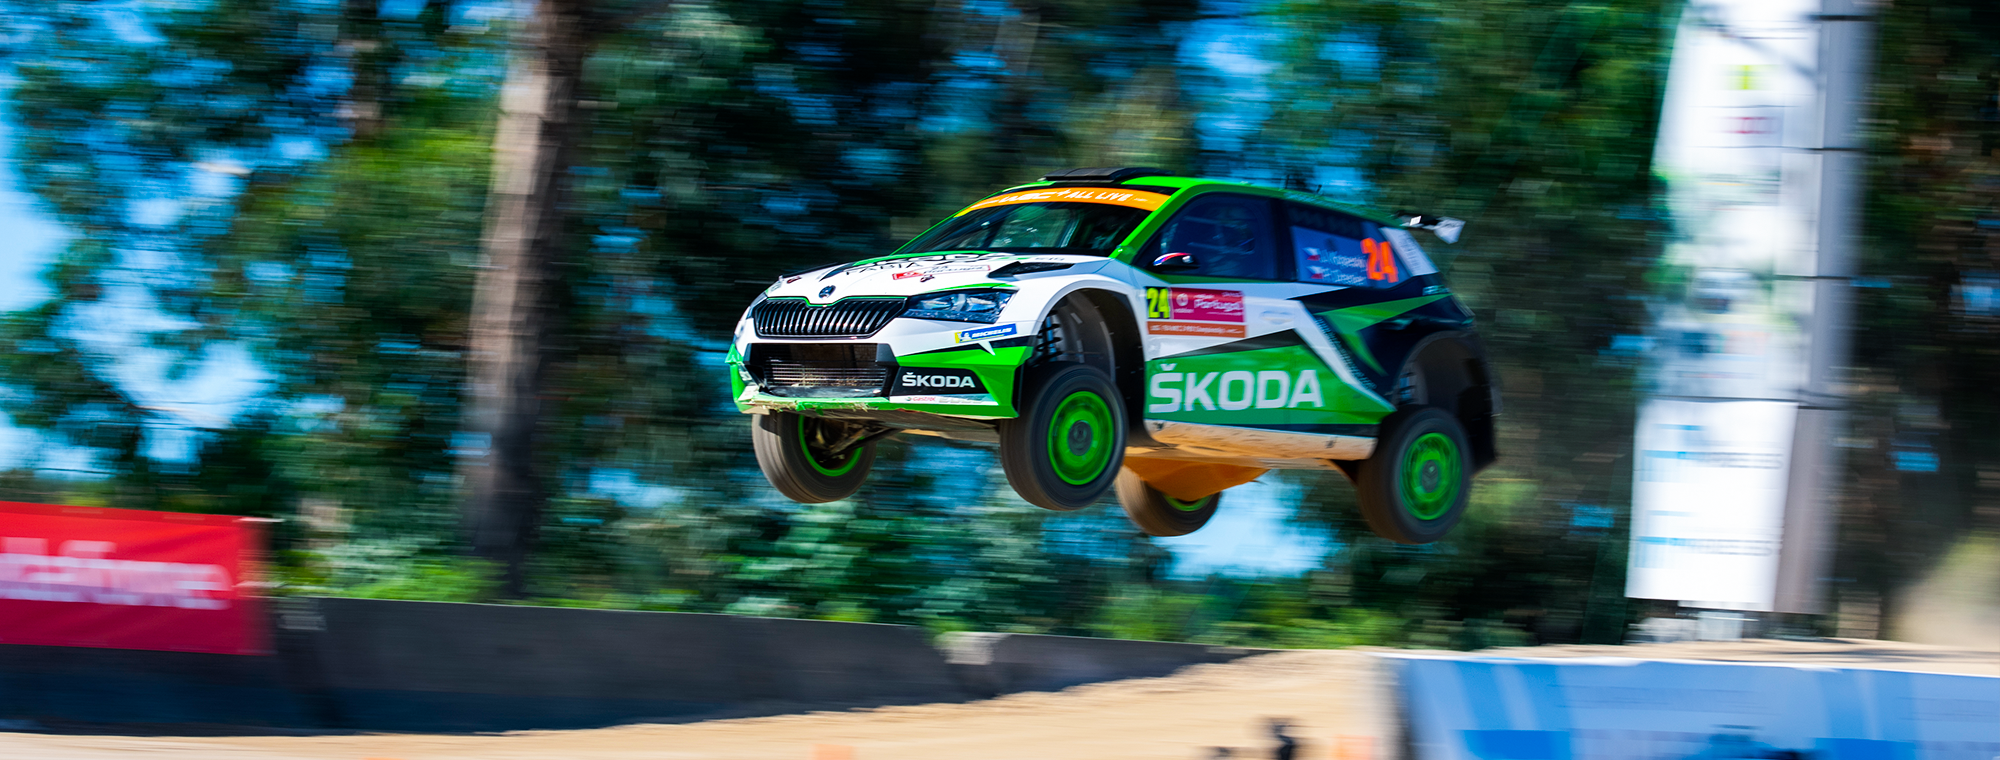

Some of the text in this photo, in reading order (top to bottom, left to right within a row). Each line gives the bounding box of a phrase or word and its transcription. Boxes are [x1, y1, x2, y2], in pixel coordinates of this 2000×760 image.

[1360, 238, 1399, 283] 24
[1146, 287, 1170, 318] 24
[902, 372, 976, 388] ŠKODA
[1149, 364, 1325, 413] ŠKODA
